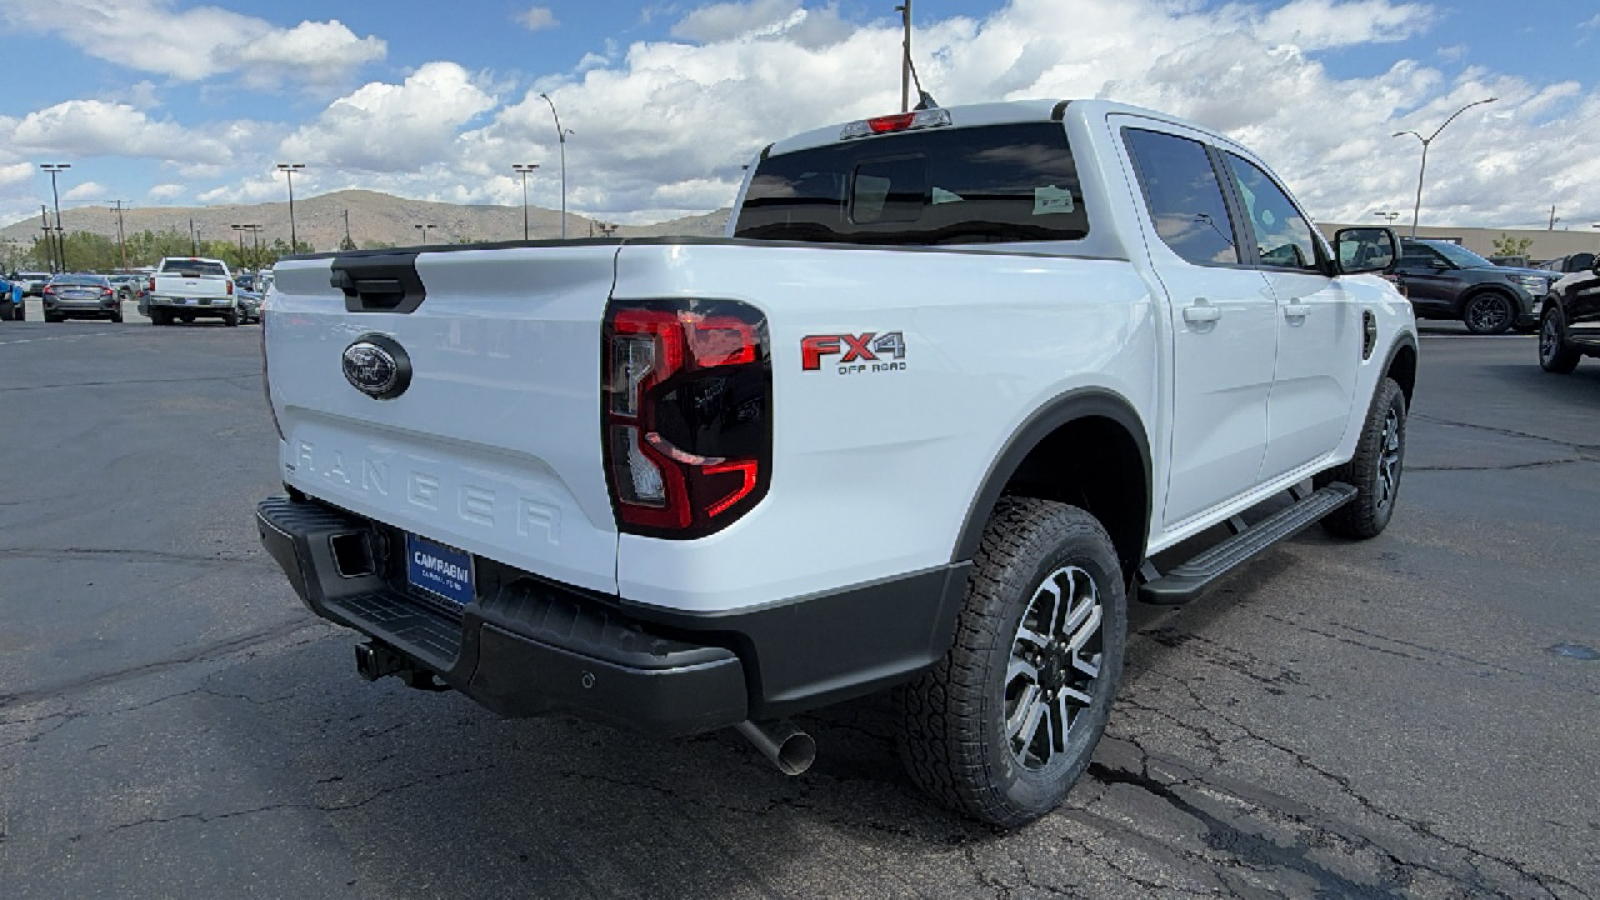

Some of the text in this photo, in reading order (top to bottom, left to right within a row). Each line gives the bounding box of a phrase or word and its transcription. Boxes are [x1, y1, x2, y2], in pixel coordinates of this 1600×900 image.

[801, 331, 906, 371] FX4
[838, 362, 907, 375] OFF ROAD
[296, 440, 562, 546] RANGER
